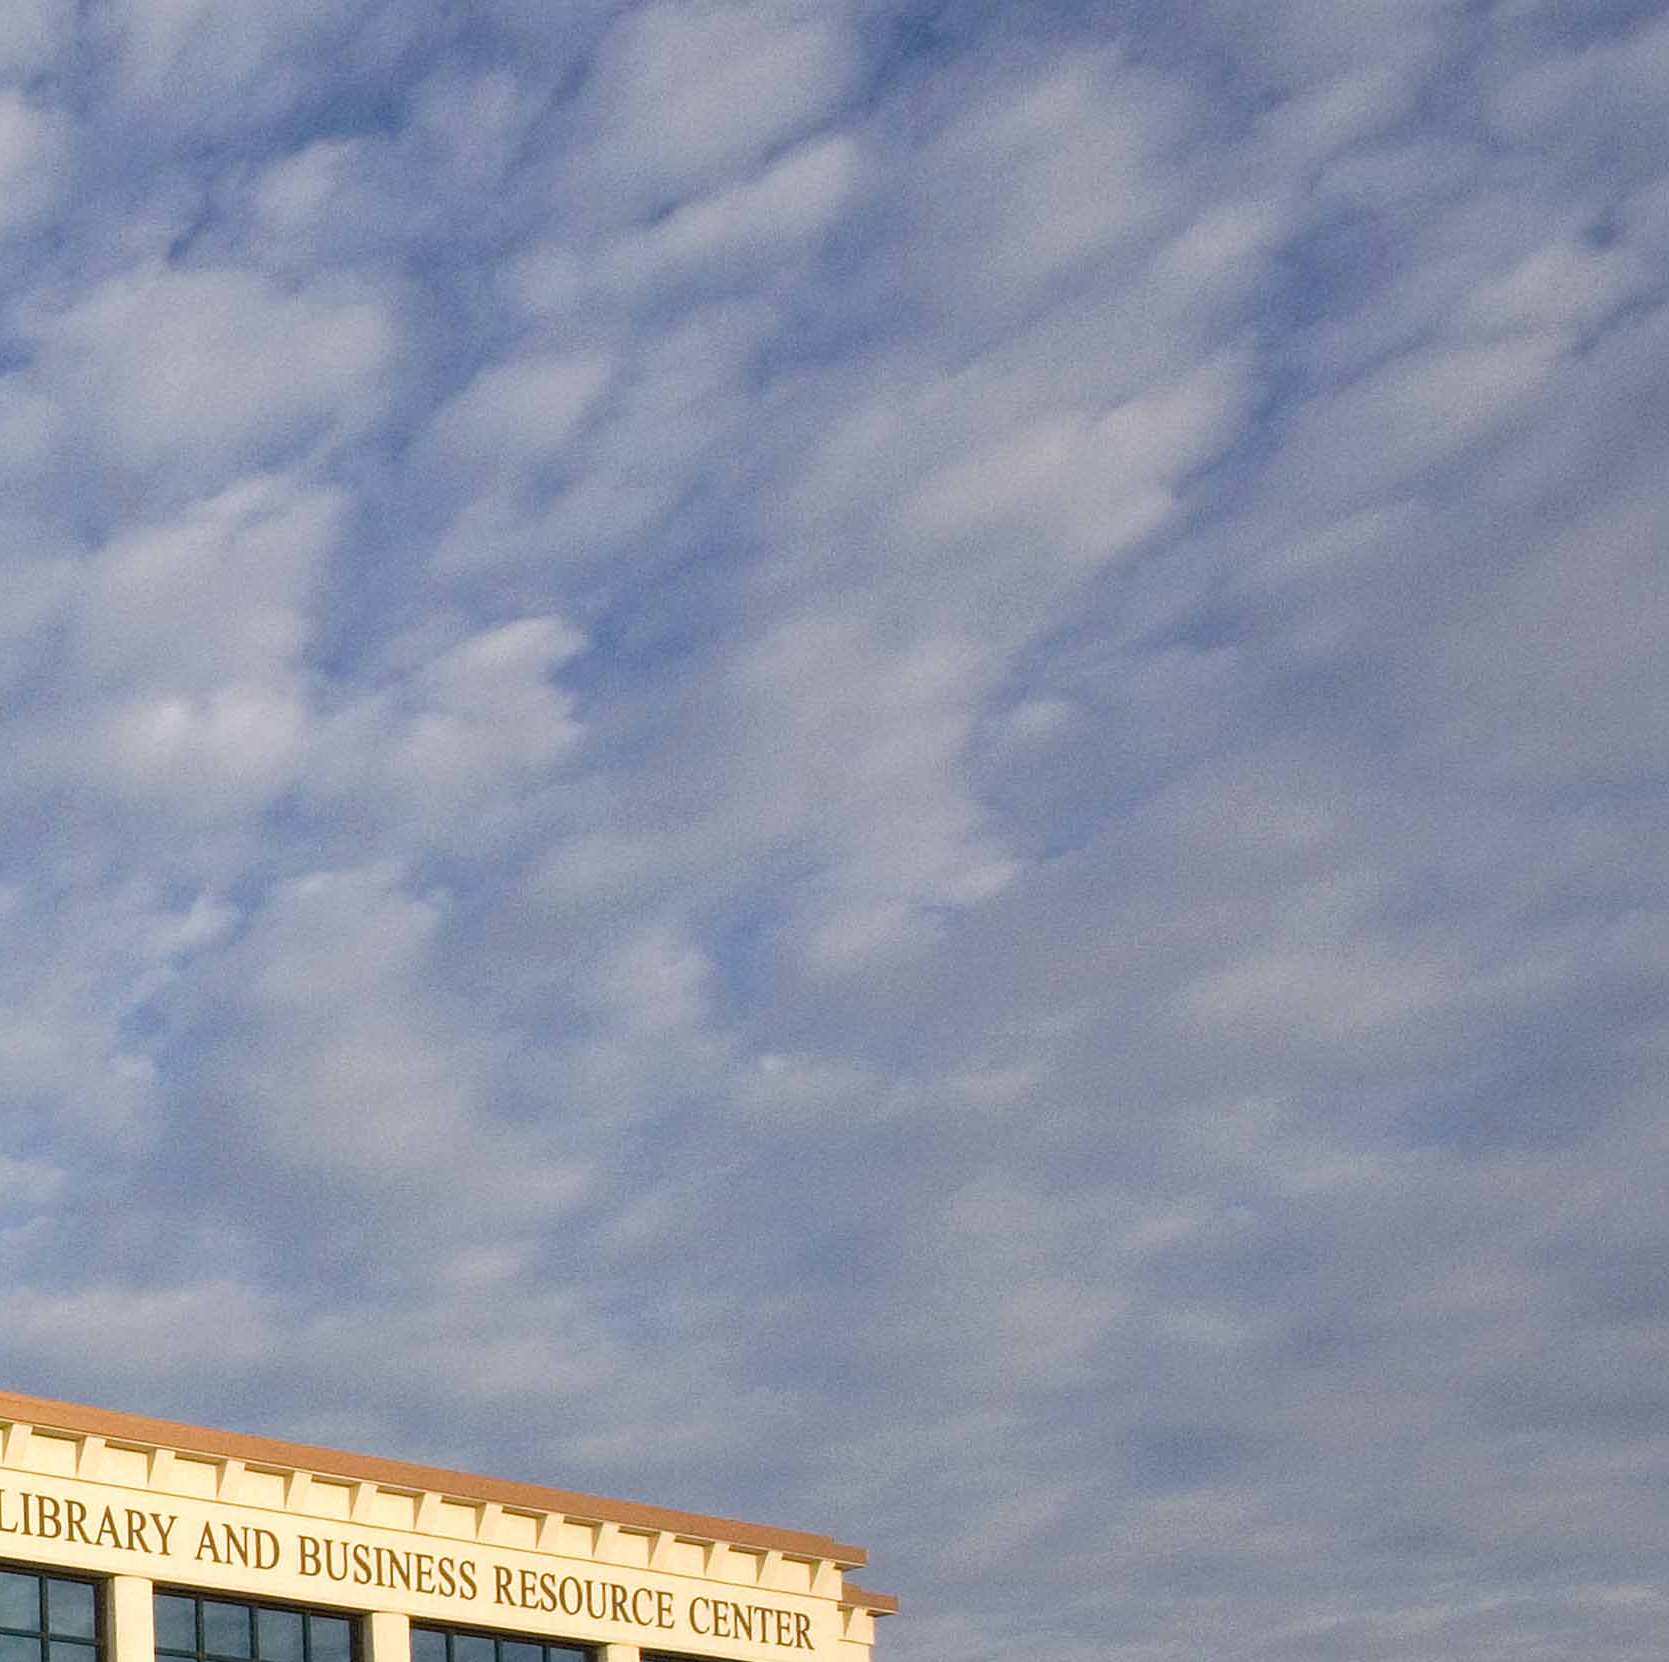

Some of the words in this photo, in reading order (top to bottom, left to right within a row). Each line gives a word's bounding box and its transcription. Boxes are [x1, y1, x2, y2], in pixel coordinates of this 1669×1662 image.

[195, 1521, 280, 1569] AND
[298, 1535, 477, 1600] BUSINESS
[493, 1565, 675, 1629] RESOURCE
[689, 1597, 815, 1650] CENTER
